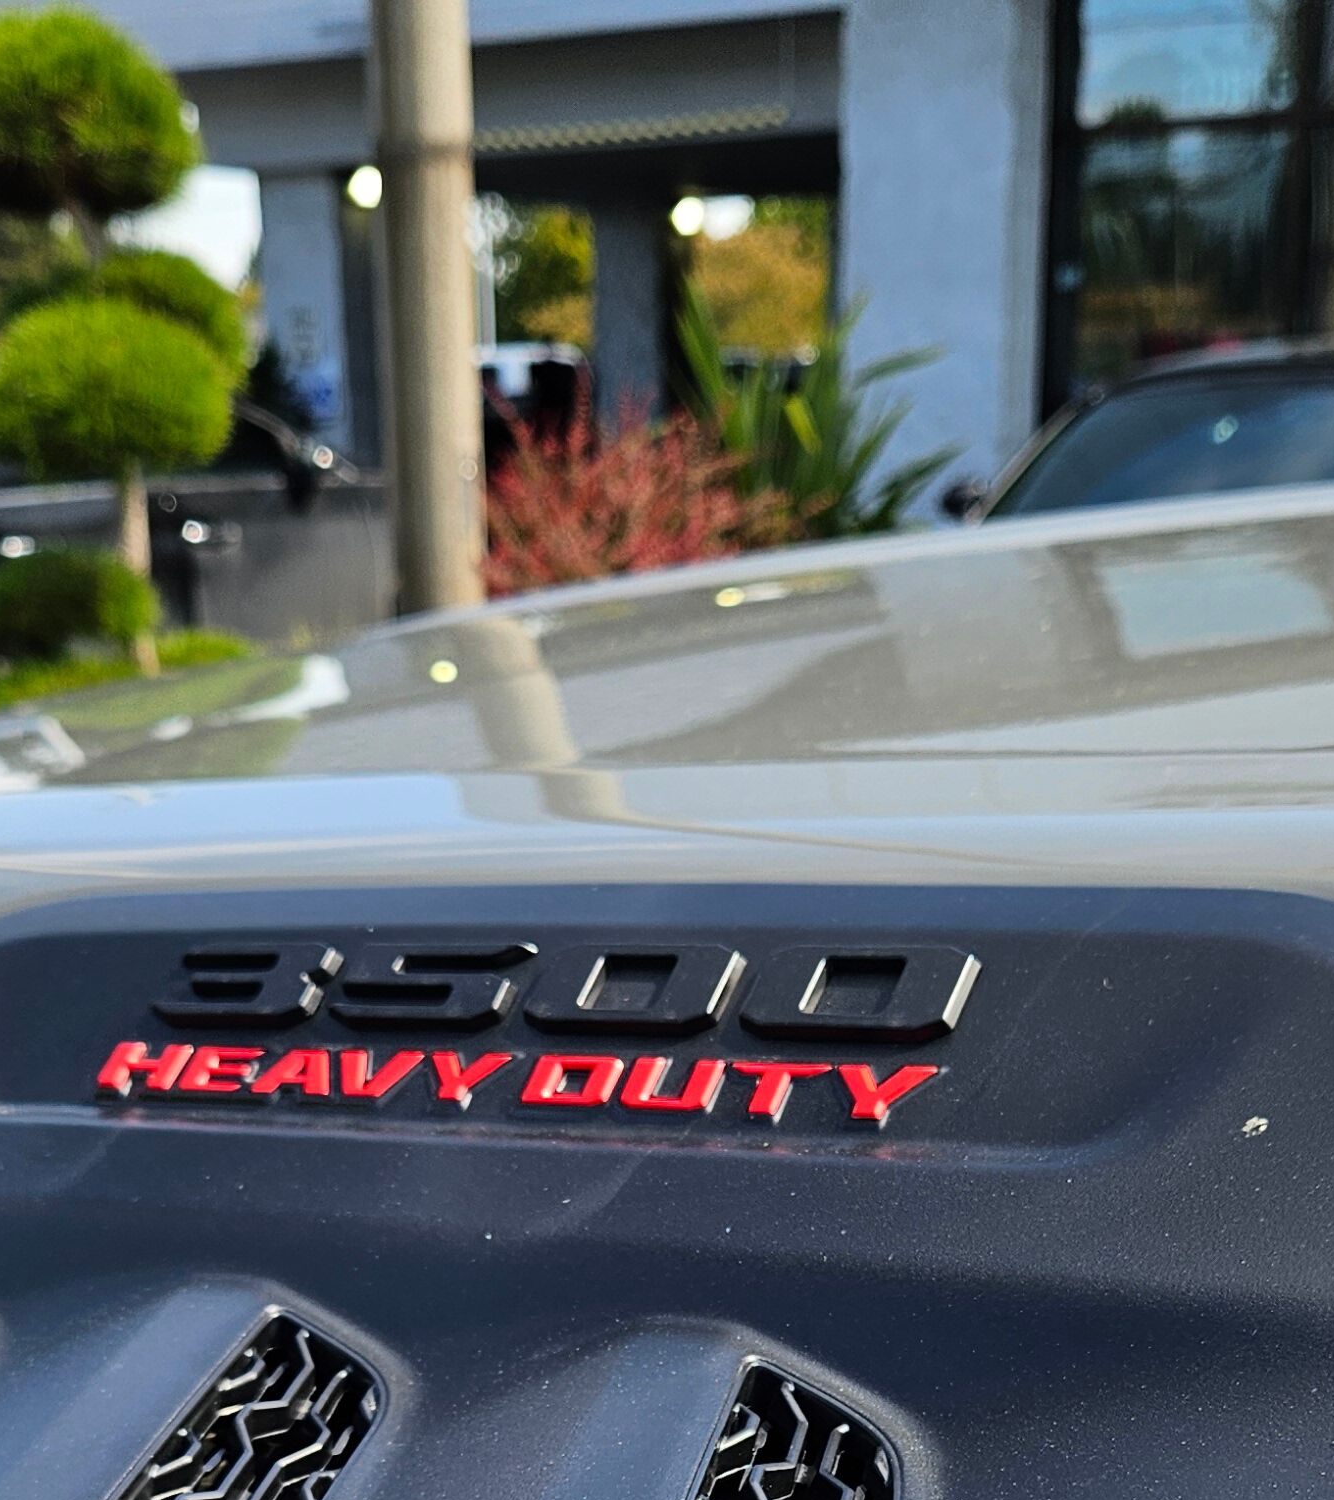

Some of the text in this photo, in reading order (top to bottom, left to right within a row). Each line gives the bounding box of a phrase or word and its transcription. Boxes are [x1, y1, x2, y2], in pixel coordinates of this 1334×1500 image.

[149, 940, 984, 1043] 3500
[95, 1040, 943, 1124] HEAVY DUTY
